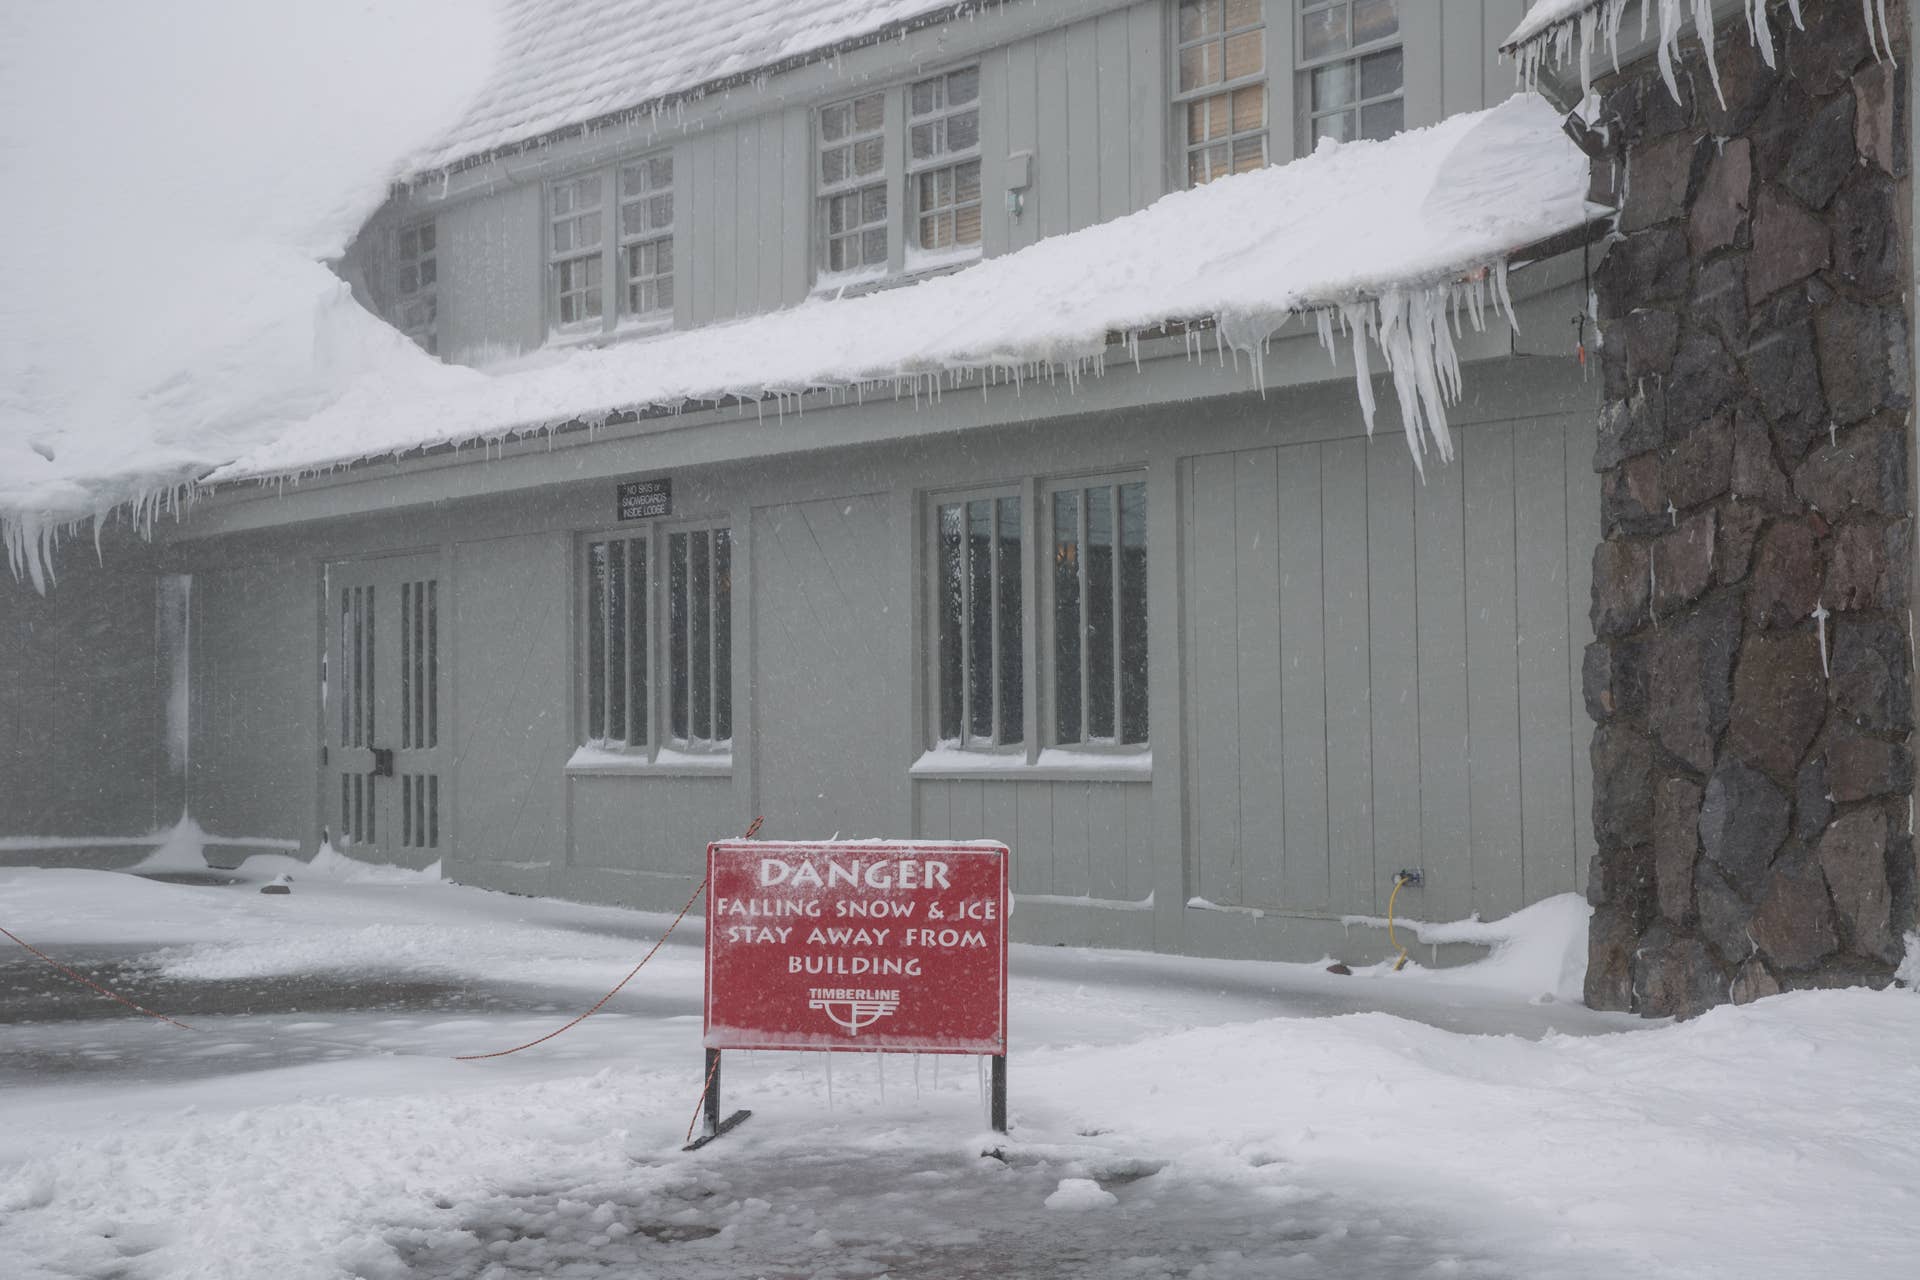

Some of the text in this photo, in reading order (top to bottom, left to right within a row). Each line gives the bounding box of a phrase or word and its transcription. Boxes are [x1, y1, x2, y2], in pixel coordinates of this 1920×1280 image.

[626, 484, 638, 495] NO
[622, 492, 667, 507] SNOWBOARDS
[623, 504, 665, 518] INSIDE LODGE
[759, 859, 951, 889] DANGER
[717, 898, 997, 920] FALLING SNOW & ICE
[728, 926, 987, 947] STAY AWAY FROM
[788, 956, 922, 976] BUILDING
[809, 988, 900, 1001] TIMBERLINE
